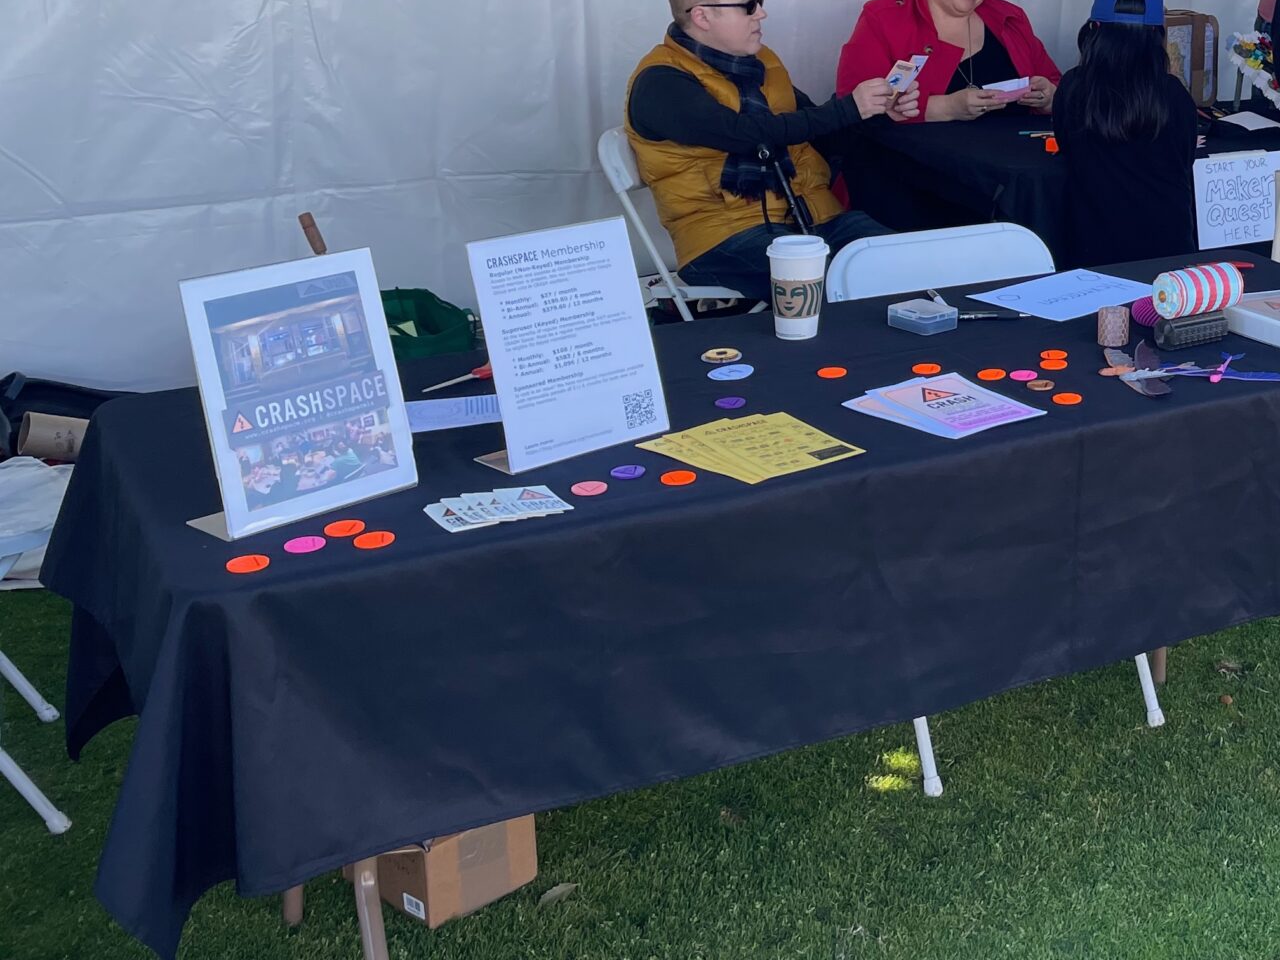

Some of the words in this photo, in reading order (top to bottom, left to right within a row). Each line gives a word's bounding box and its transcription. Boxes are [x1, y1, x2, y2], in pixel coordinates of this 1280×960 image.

[1205, 161, 1236, 174] START
[1244, 158, 1268, 171] YOUR
[1205, 174, 1275, 203] Maker
[1206, 198, 1272, 227] Quest
[1224, 224, 1262, 242] HERE
[486, 250, 539, 270] CRASHSPACE
[540, 240, 606, 259] Membership
[255, 375, 386, 428] CRASHSPACE
[926, 395, 977, 410] CRASH
